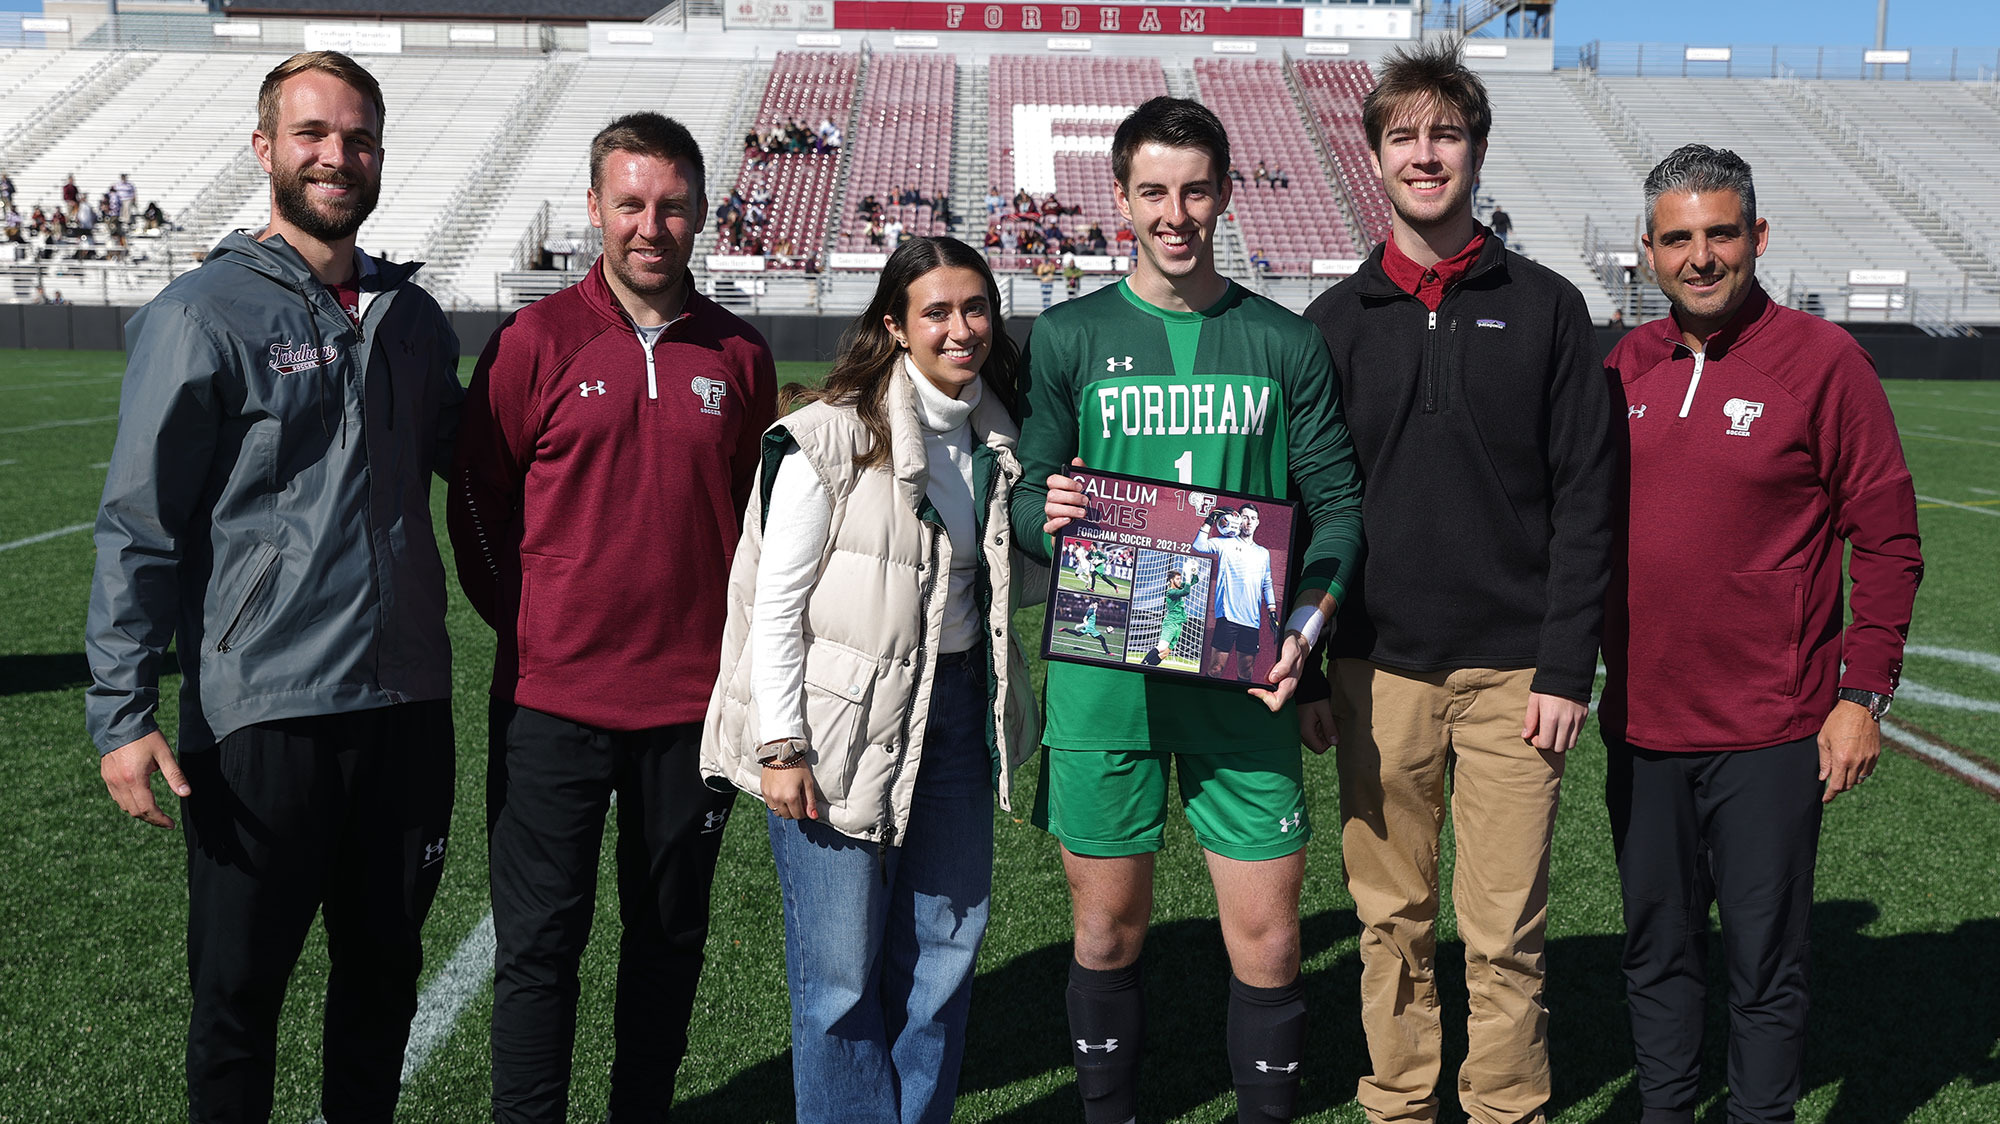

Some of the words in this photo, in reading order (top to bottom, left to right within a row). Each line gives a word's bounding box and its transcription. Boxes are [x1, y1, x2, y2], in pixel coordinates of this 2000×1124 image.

[947, 5, 1205, 32] FORDHAM
[700, 408, 722, 416] SOCCER
[1098, 383, 1270, 439] FORDHAM
[1174, 450, 1193, 485] 1
[1174, 489, 1186, 512] 1
[1076, 526, 1118, 543] FORDHAM
[1119, 533, 1153, 548] SOCCER
[1156, 538, 1192, 554] 2021-22
